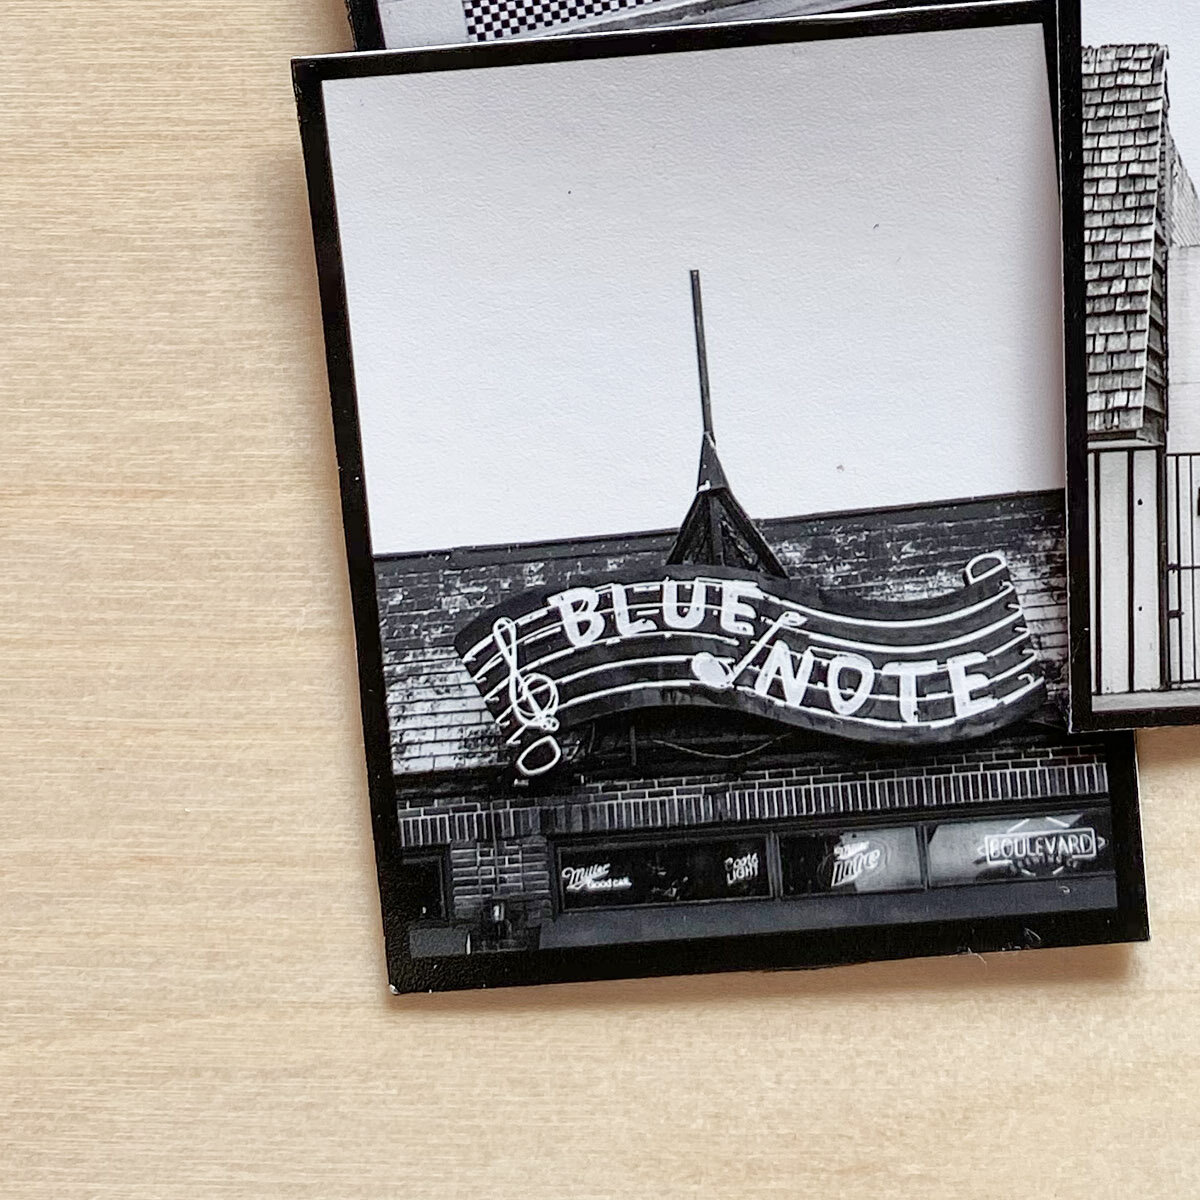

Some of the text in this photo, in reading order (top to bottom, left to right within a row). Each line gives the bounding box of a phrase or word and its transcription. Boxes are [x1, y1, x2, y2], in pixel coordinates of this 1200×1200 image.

[547, 577, 762, 648] BLUE
[755, 640, 992, 723] NOTE
[989, 833, 1092, 859] BOULEVARD
[561, 863, 610, 890] Miller
